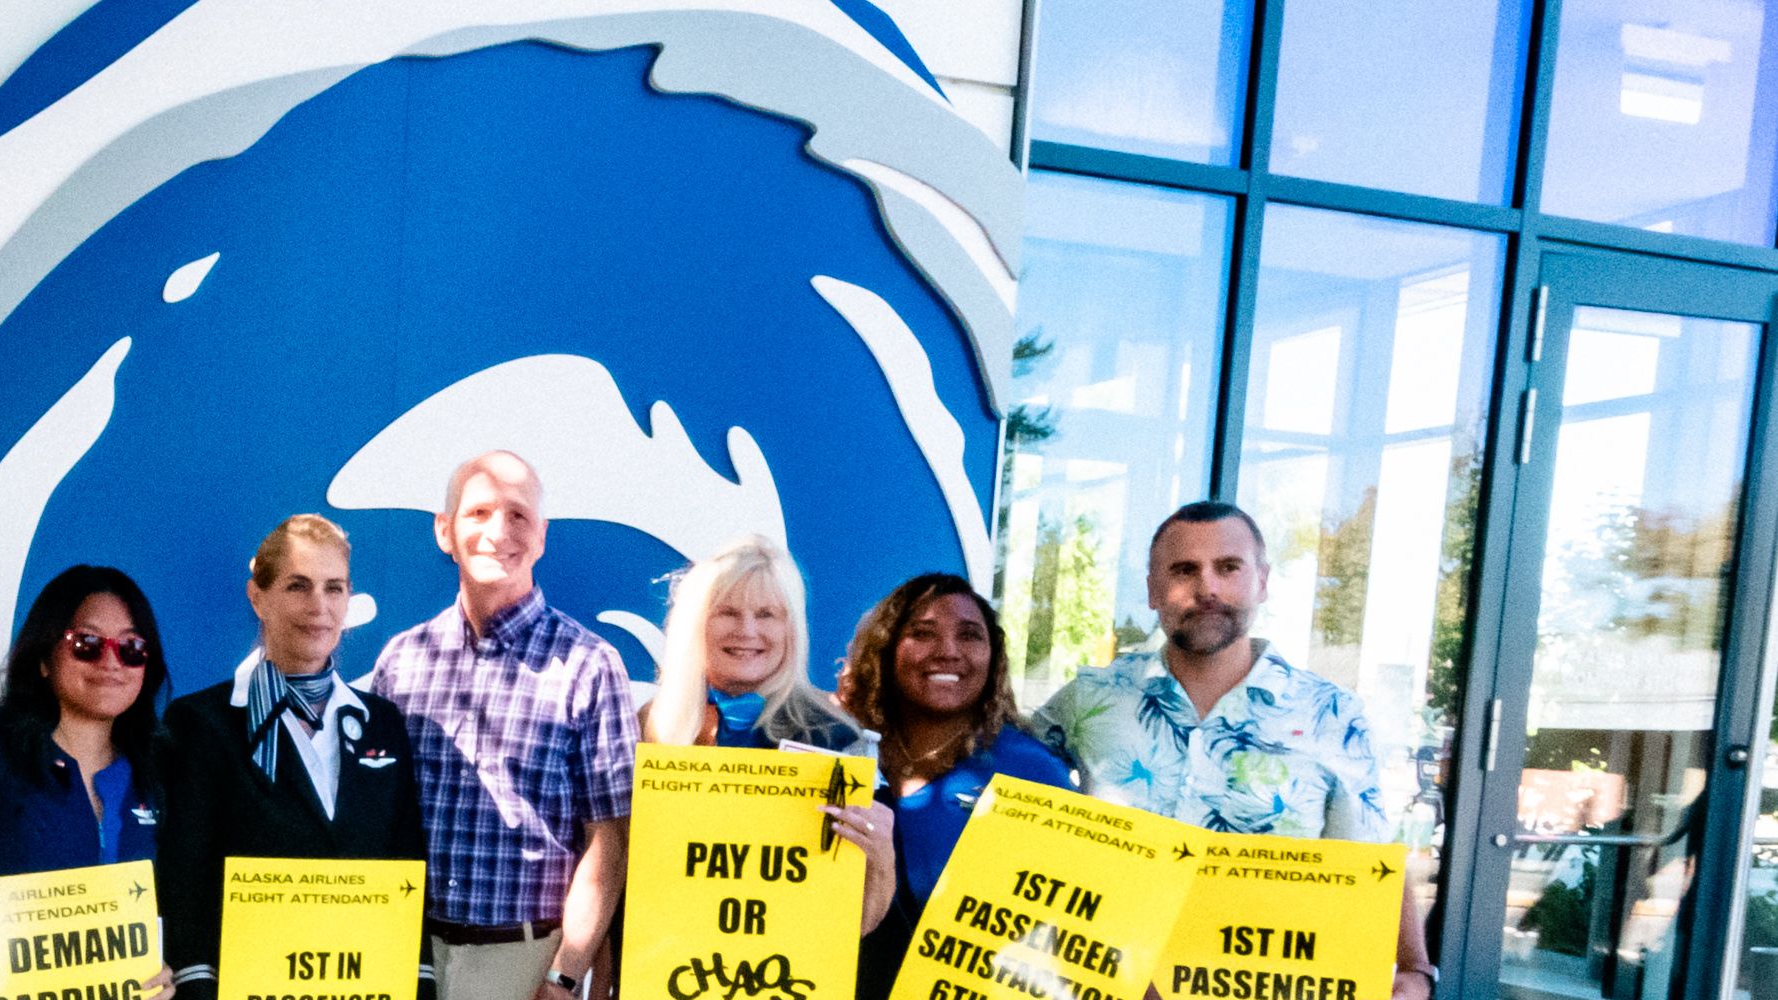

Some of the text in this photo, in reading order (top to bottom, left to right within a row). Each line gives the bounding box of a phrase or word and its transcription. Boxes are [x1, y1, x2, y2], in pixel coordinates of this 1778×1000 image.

[642, 759, 799, 777] ALASKA AIRLINES
[641, 780, 829, 799] FLIGHT ATTENDANTS
[995, 786, 1134, 832] ALASKA AIRLINES
[992, 803, 1157, 860] LIGHT ATTENDANTS
[686, 842, 809, 883] PAY US
[1236, 848, 1323, 864] AIRLINES
[231, 872, 366, 886] ALASKA AIRLINES
[1226, 867, 1356, 886] ATTENDANTS
[9, 884, 87, 902] AIRLINES
[230, 891, 390, 905] FLIGHT ATTENDANTS
[1012, 870, 1103, 922] 1ST IN
[2, 900, 119, 924] ATTENDANTS
[718, 897, 767, 935] OR
[8, 921, 149, 974] DEMAND
[954, 895, 1123, 979] PASSENGER
[1219, 925, 1316, 961] 1ST IN
[285, 951, 363, 981] 1ST IN
